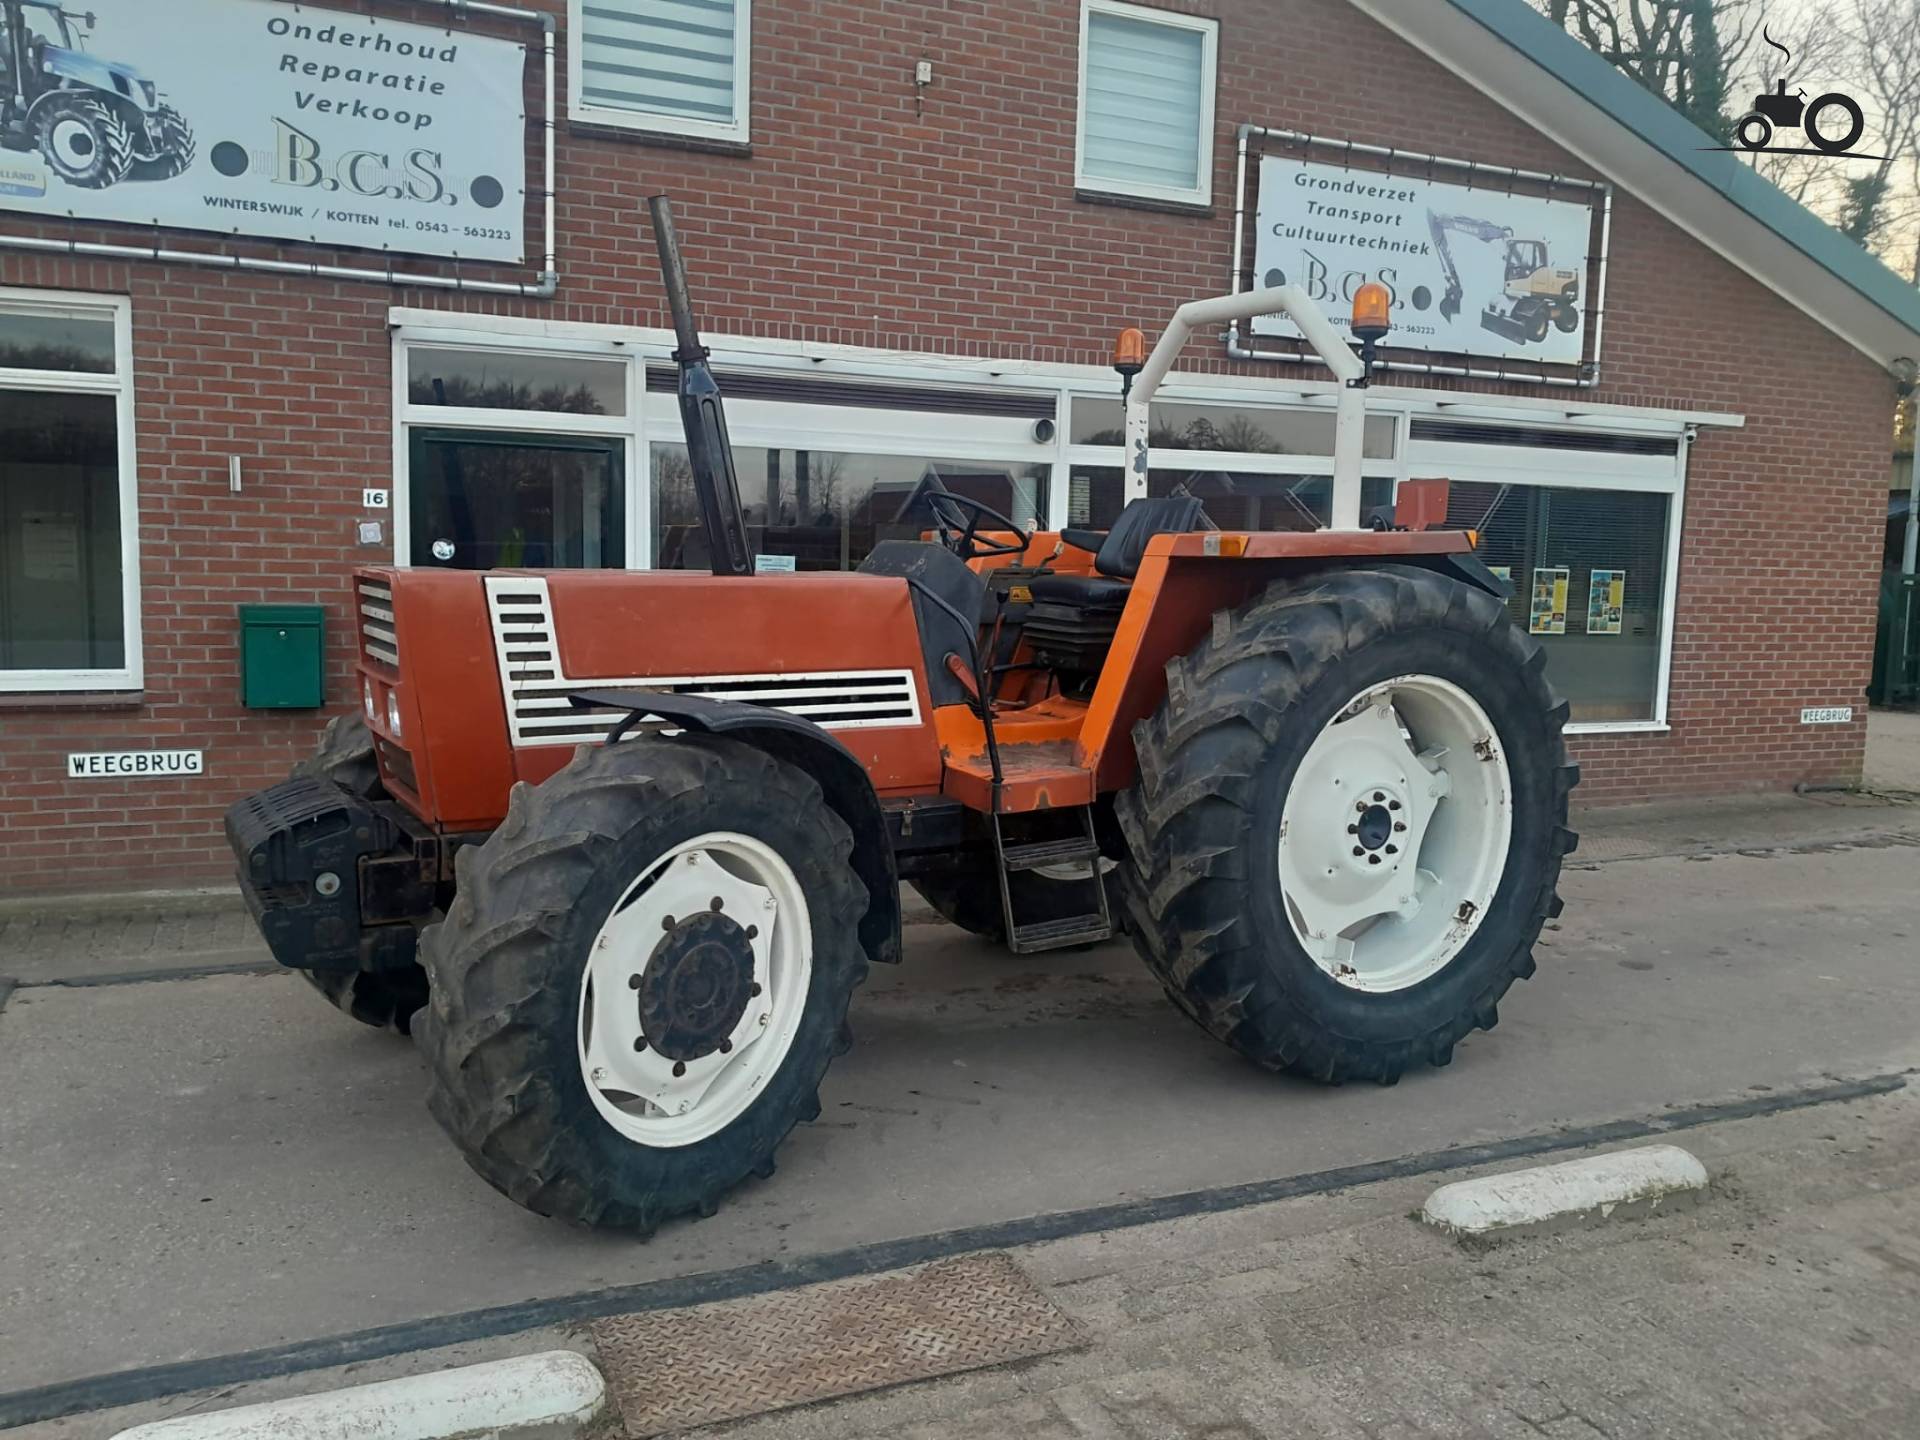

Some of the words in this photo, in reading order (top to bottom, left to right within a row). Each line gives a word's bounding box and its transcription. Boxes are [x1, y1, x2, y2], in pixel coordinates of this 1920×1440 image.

[267, 17, 458, 63] Onderhoud
[279, 53, 446, 95] Reparatie
[295, 91, 433, 130] Verkoop
[270, 115, 458, 207] B.C.S.
[1294, 172, 1416, 203] Grondverzet
[203, 195, 304, 217] WINTERSWIJK
[311, 208, 320, 219] /
[326, 210, 379, 226] KOTTEN
[388, 218, 409, 229] tel.
[415, 220, 448, 234] 0543
[463, 226, 511, 241] 563223
[1307, 200, 1403, 226] Transport
[1272, 222, 1431, 255] Cultuurtechniek
[1302, 248, 1405, 310] B.CS.
[1328, 316, 1351, 326] KOTT
[366, 492, 384, 505] 16
[1802, 708, 1850, 721] WEEGBRUG
[73, 753, 197, 774] WEEGBRUG
